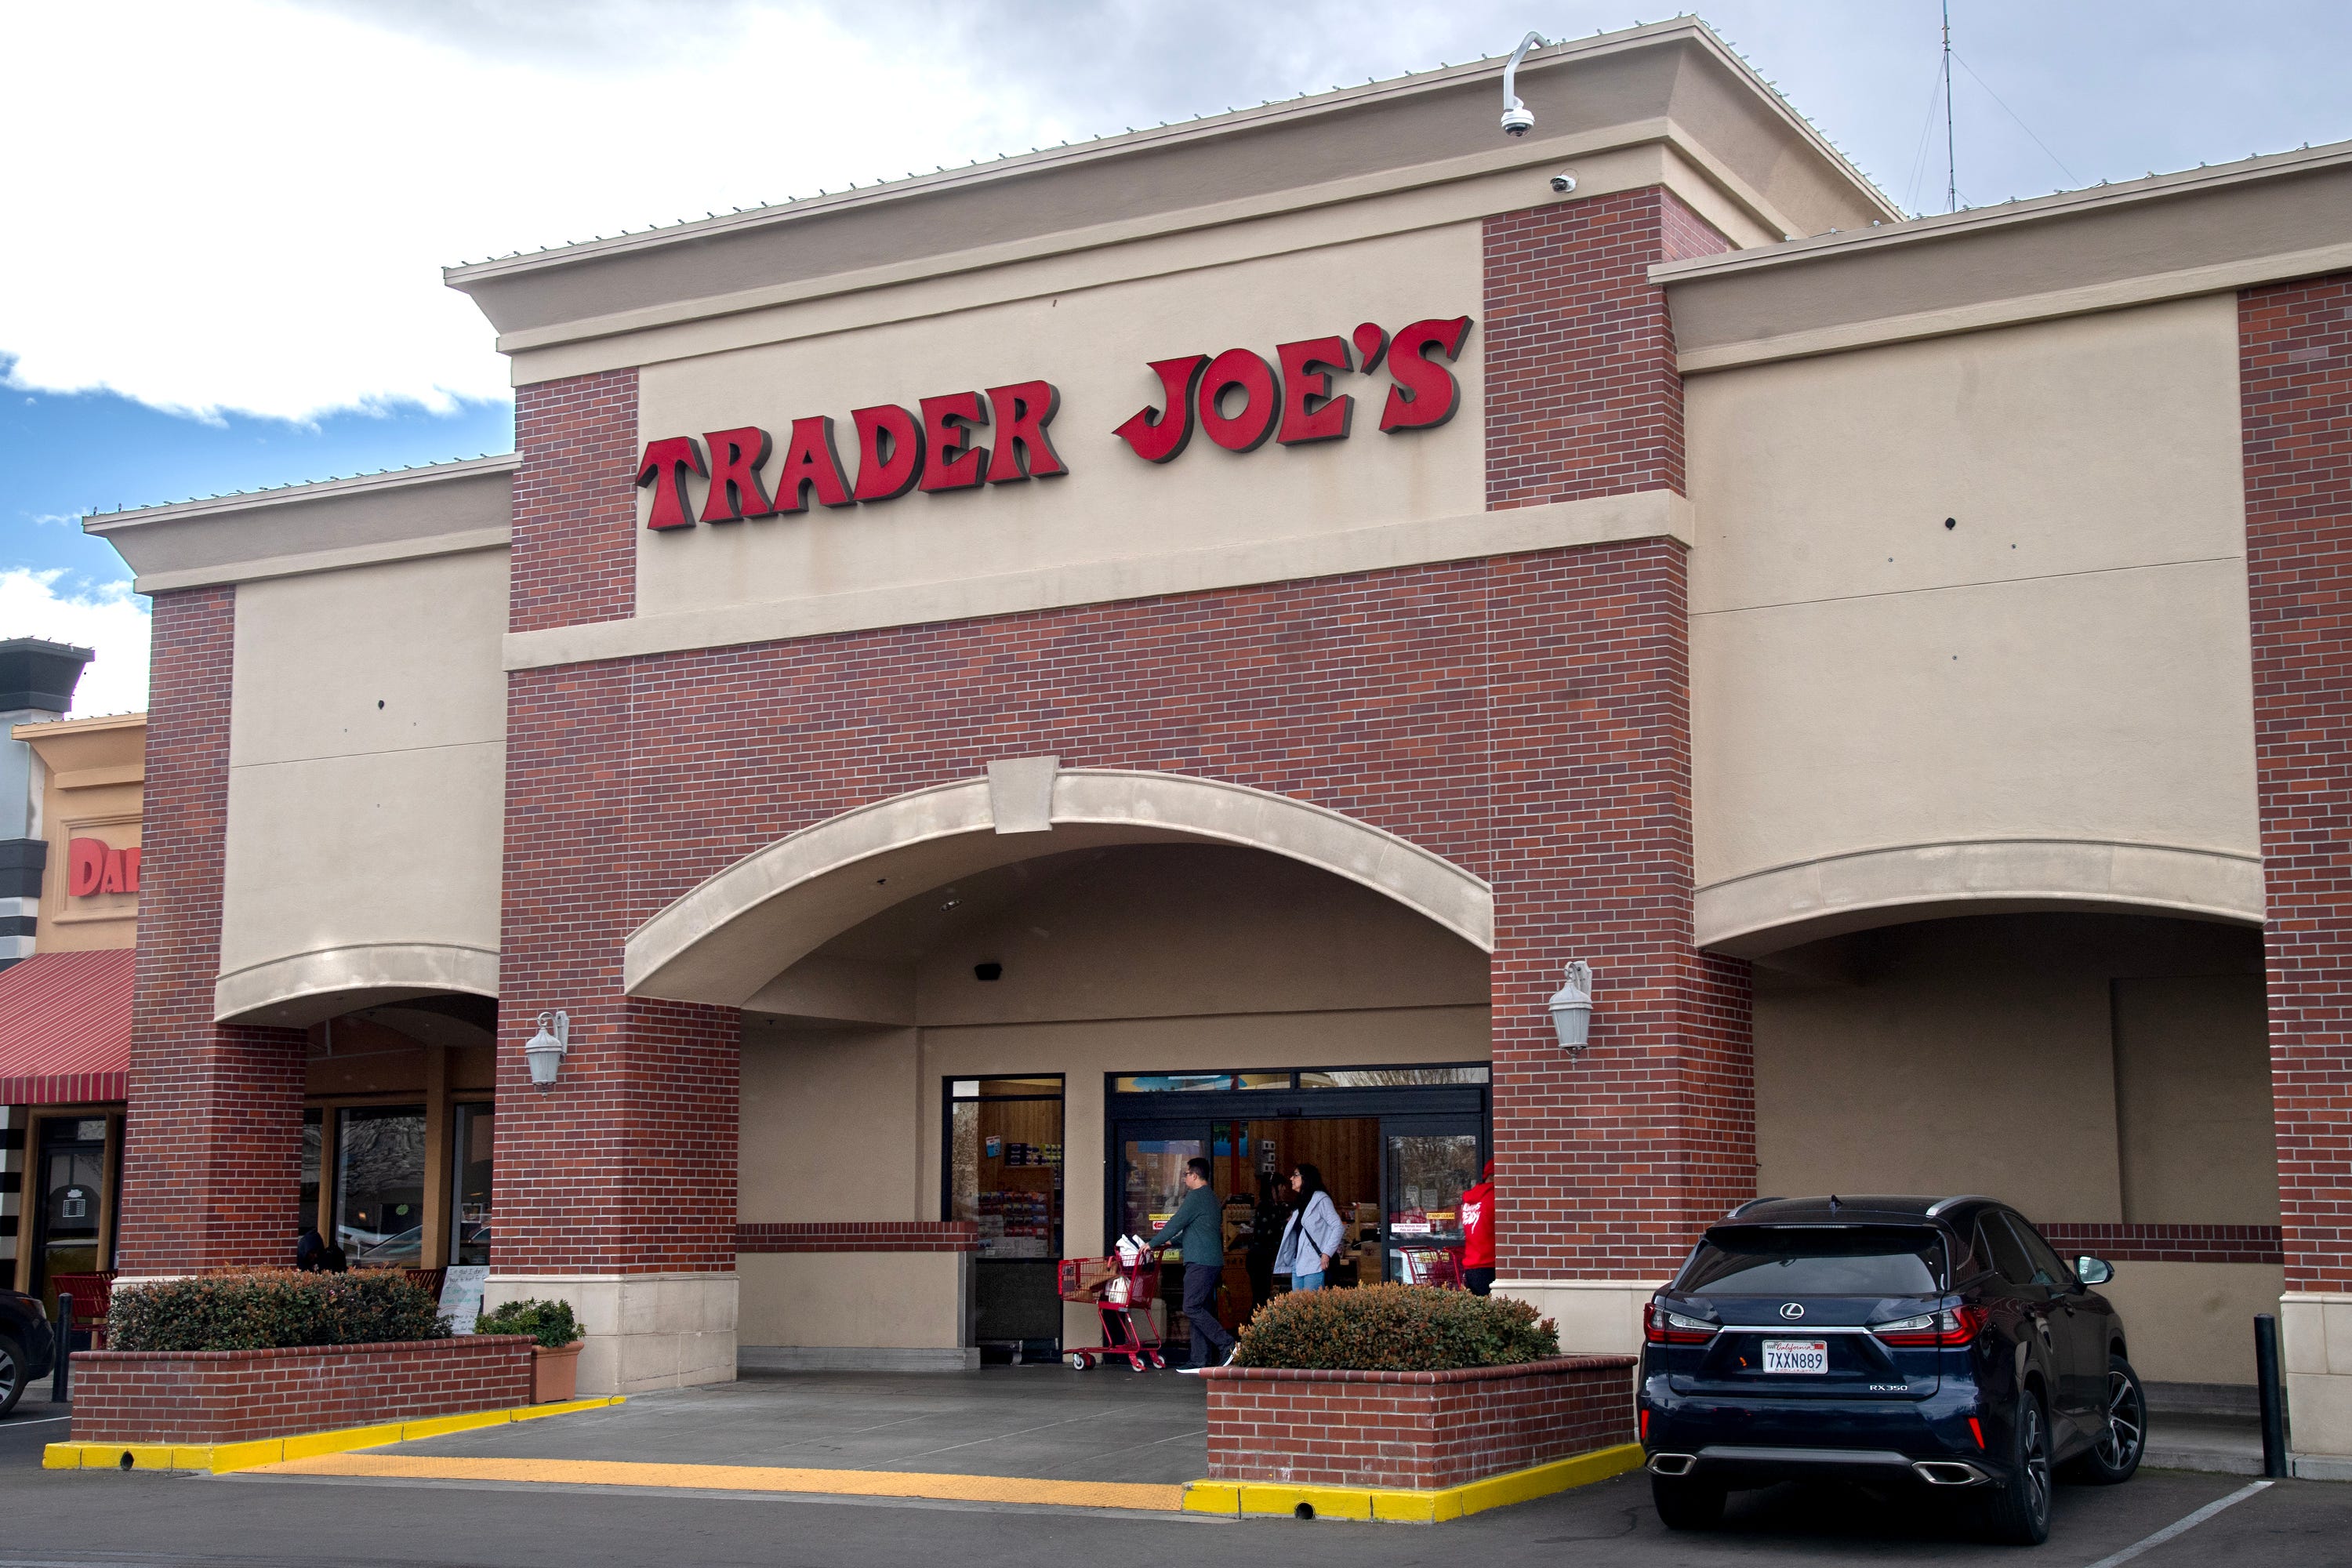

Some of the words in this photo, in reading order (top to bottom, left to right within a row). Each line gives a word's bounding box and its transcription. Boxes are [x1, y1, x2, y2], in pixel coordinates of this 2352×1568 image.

[636, 379, 1069, 532] TRADER
[1112, 315, 1474, 464] JOE'S
[1776, 1342, 1811, 1352] California
[1768, 1352, 1823, 1369] 7XXN889
